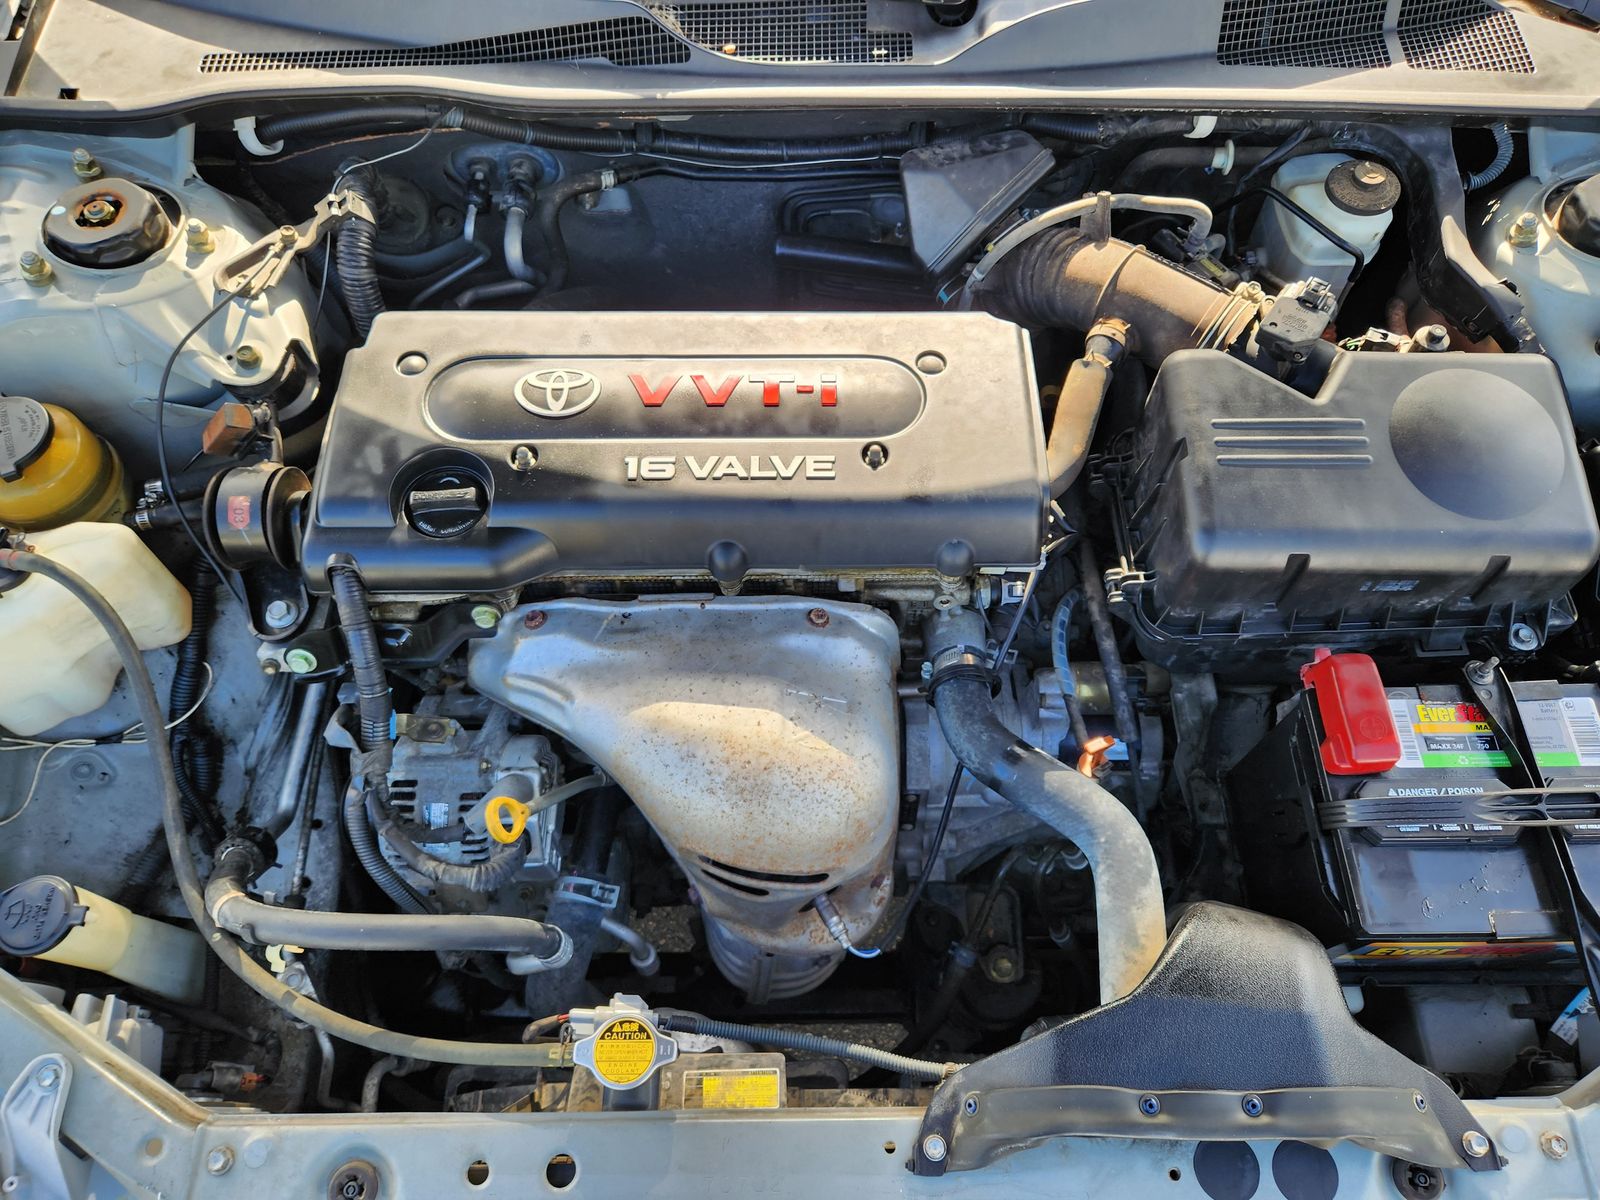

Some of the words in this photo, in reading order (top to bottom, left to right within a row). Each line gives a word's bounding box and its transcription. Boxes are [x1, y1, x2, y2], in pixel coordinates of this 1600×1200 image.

[627, 374, 838, 407] VVT-i
[624, 455, 677, 482] 16
[683, 455, 836, 481] VALVE
[1415, 703, 1486, 723] EverSta
[1397, 788, 1438, 796] DANGER
[1447, 787, 1484, 796] POISON
[604, 1032, 647, 1040] CAUTION
